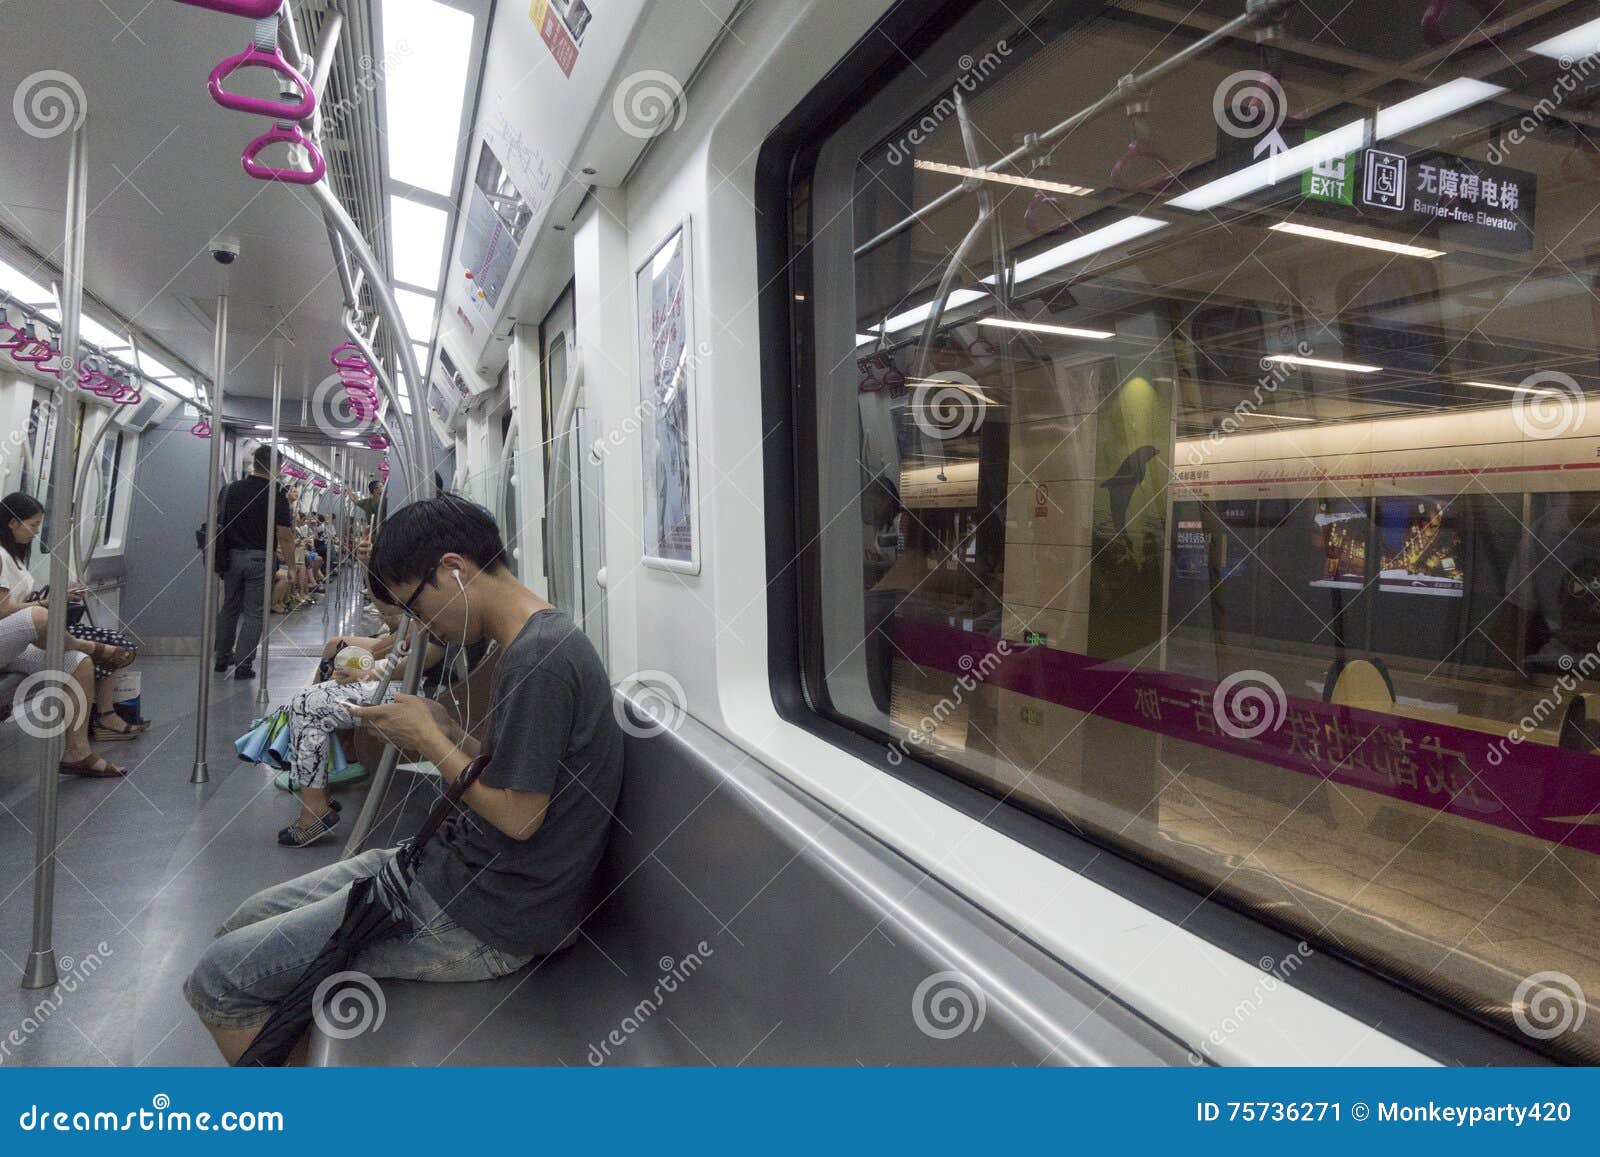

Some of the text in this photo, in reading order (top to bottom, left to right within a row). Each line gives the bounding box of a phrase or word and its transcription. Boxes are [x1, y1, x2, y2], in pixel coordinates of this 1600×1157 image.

[1311, 176, 1345, 199] EXIT
[1417, 164, 1519, 211] 无障碍电梯
[1414, 199, 1518, 231] Barrier-free Elevator
